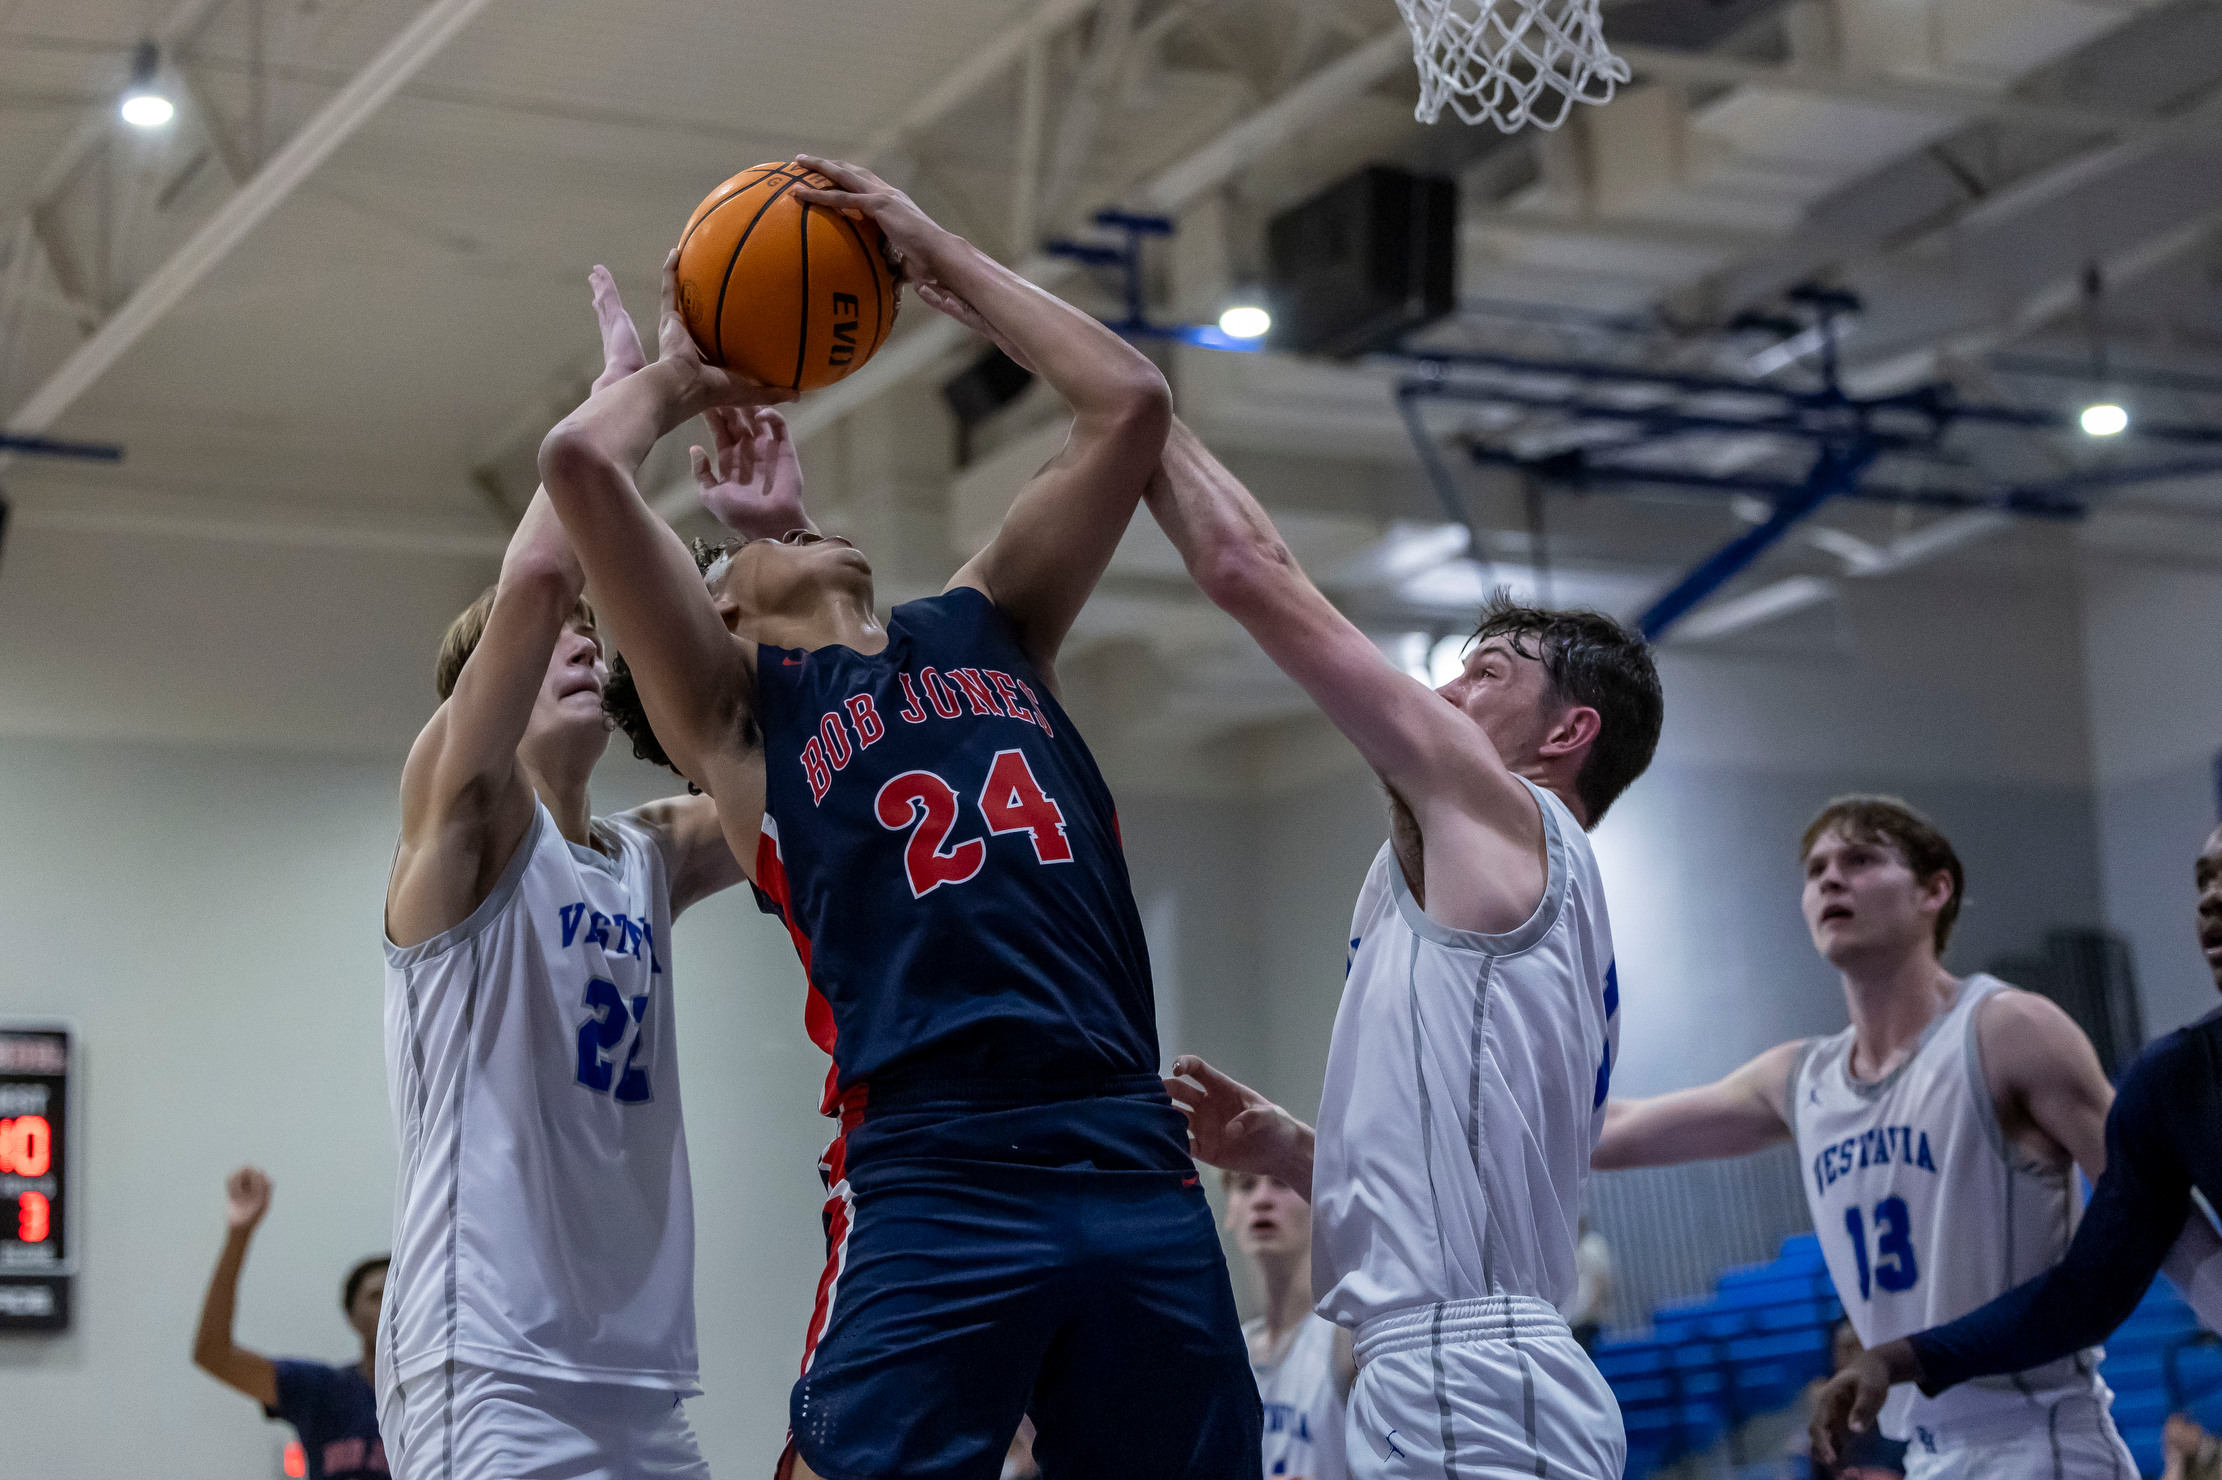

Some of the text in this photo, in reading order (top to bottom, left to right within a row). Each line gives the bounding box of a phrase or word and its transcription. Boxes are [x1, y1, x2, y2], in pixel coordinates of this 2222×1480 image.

[800, 666, 1054, 808] BOB JONES
[874, 748, 1074, 899] 24
[1845, 1194, 1918, 1302] 13
